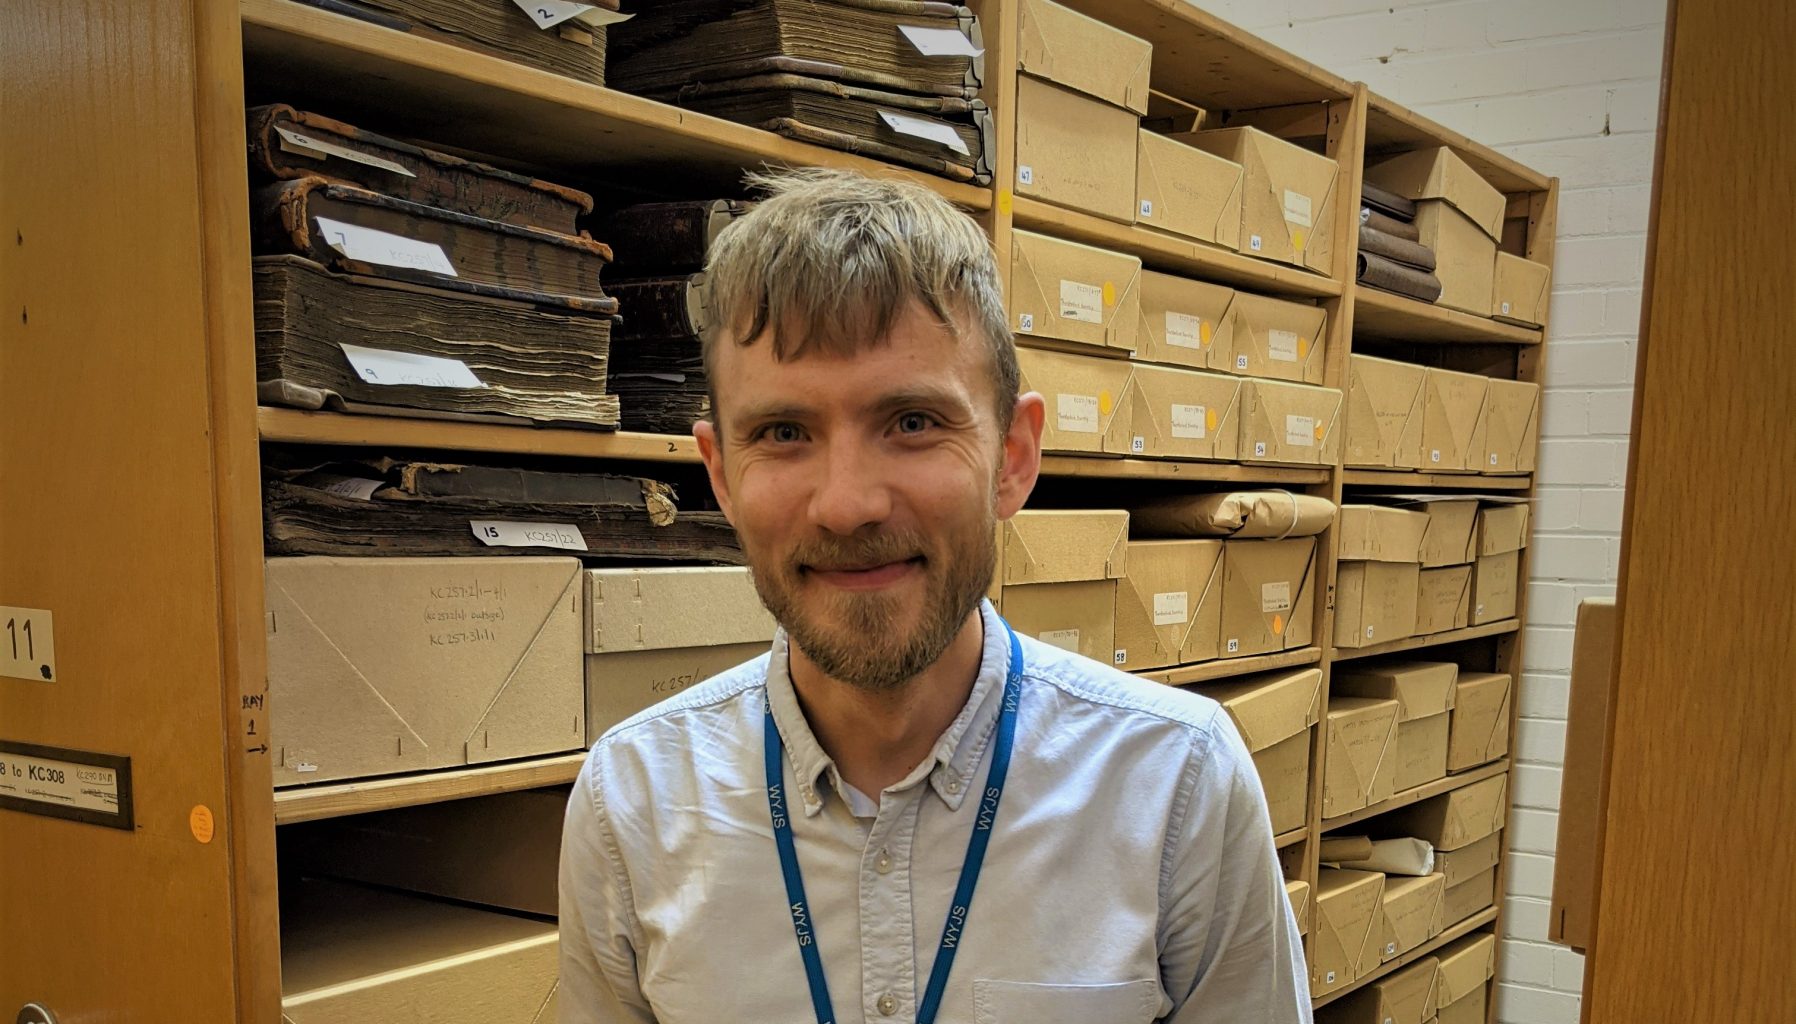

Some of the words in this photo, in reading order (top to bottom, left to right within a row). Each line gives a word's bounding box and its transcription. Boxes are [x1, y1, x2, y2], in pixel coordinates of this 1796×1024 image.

[537, 8, 554, 19] 2
[1021, 171, 1030, 182] 47
[334, 231, 347, 246] 7
[1238, 358, 1246, 367] 55
[365, 368, 378, 380] 9
[668, 442, 678, 452] 2
[1134, 439, 1143, 450] 53
[484, 527, 499, 538] 15
[6, 618, 33, 661] 11
[1229, 643, 1237, 651] 59
[1115, 654, 1125, 663] 58
[652, 667, 707, 693] KC257/
[1005, 672, 1022, 713] WYJS
[12, 764, 22, 778] to
[28, 764, 65, 784] KC308
[768, 784, 786, 829] WYJS
[977, 787, 1000, 831] WYJS
[792, 902, 811, 946] WYJS
[943, 905, 966, 950] WYJS
